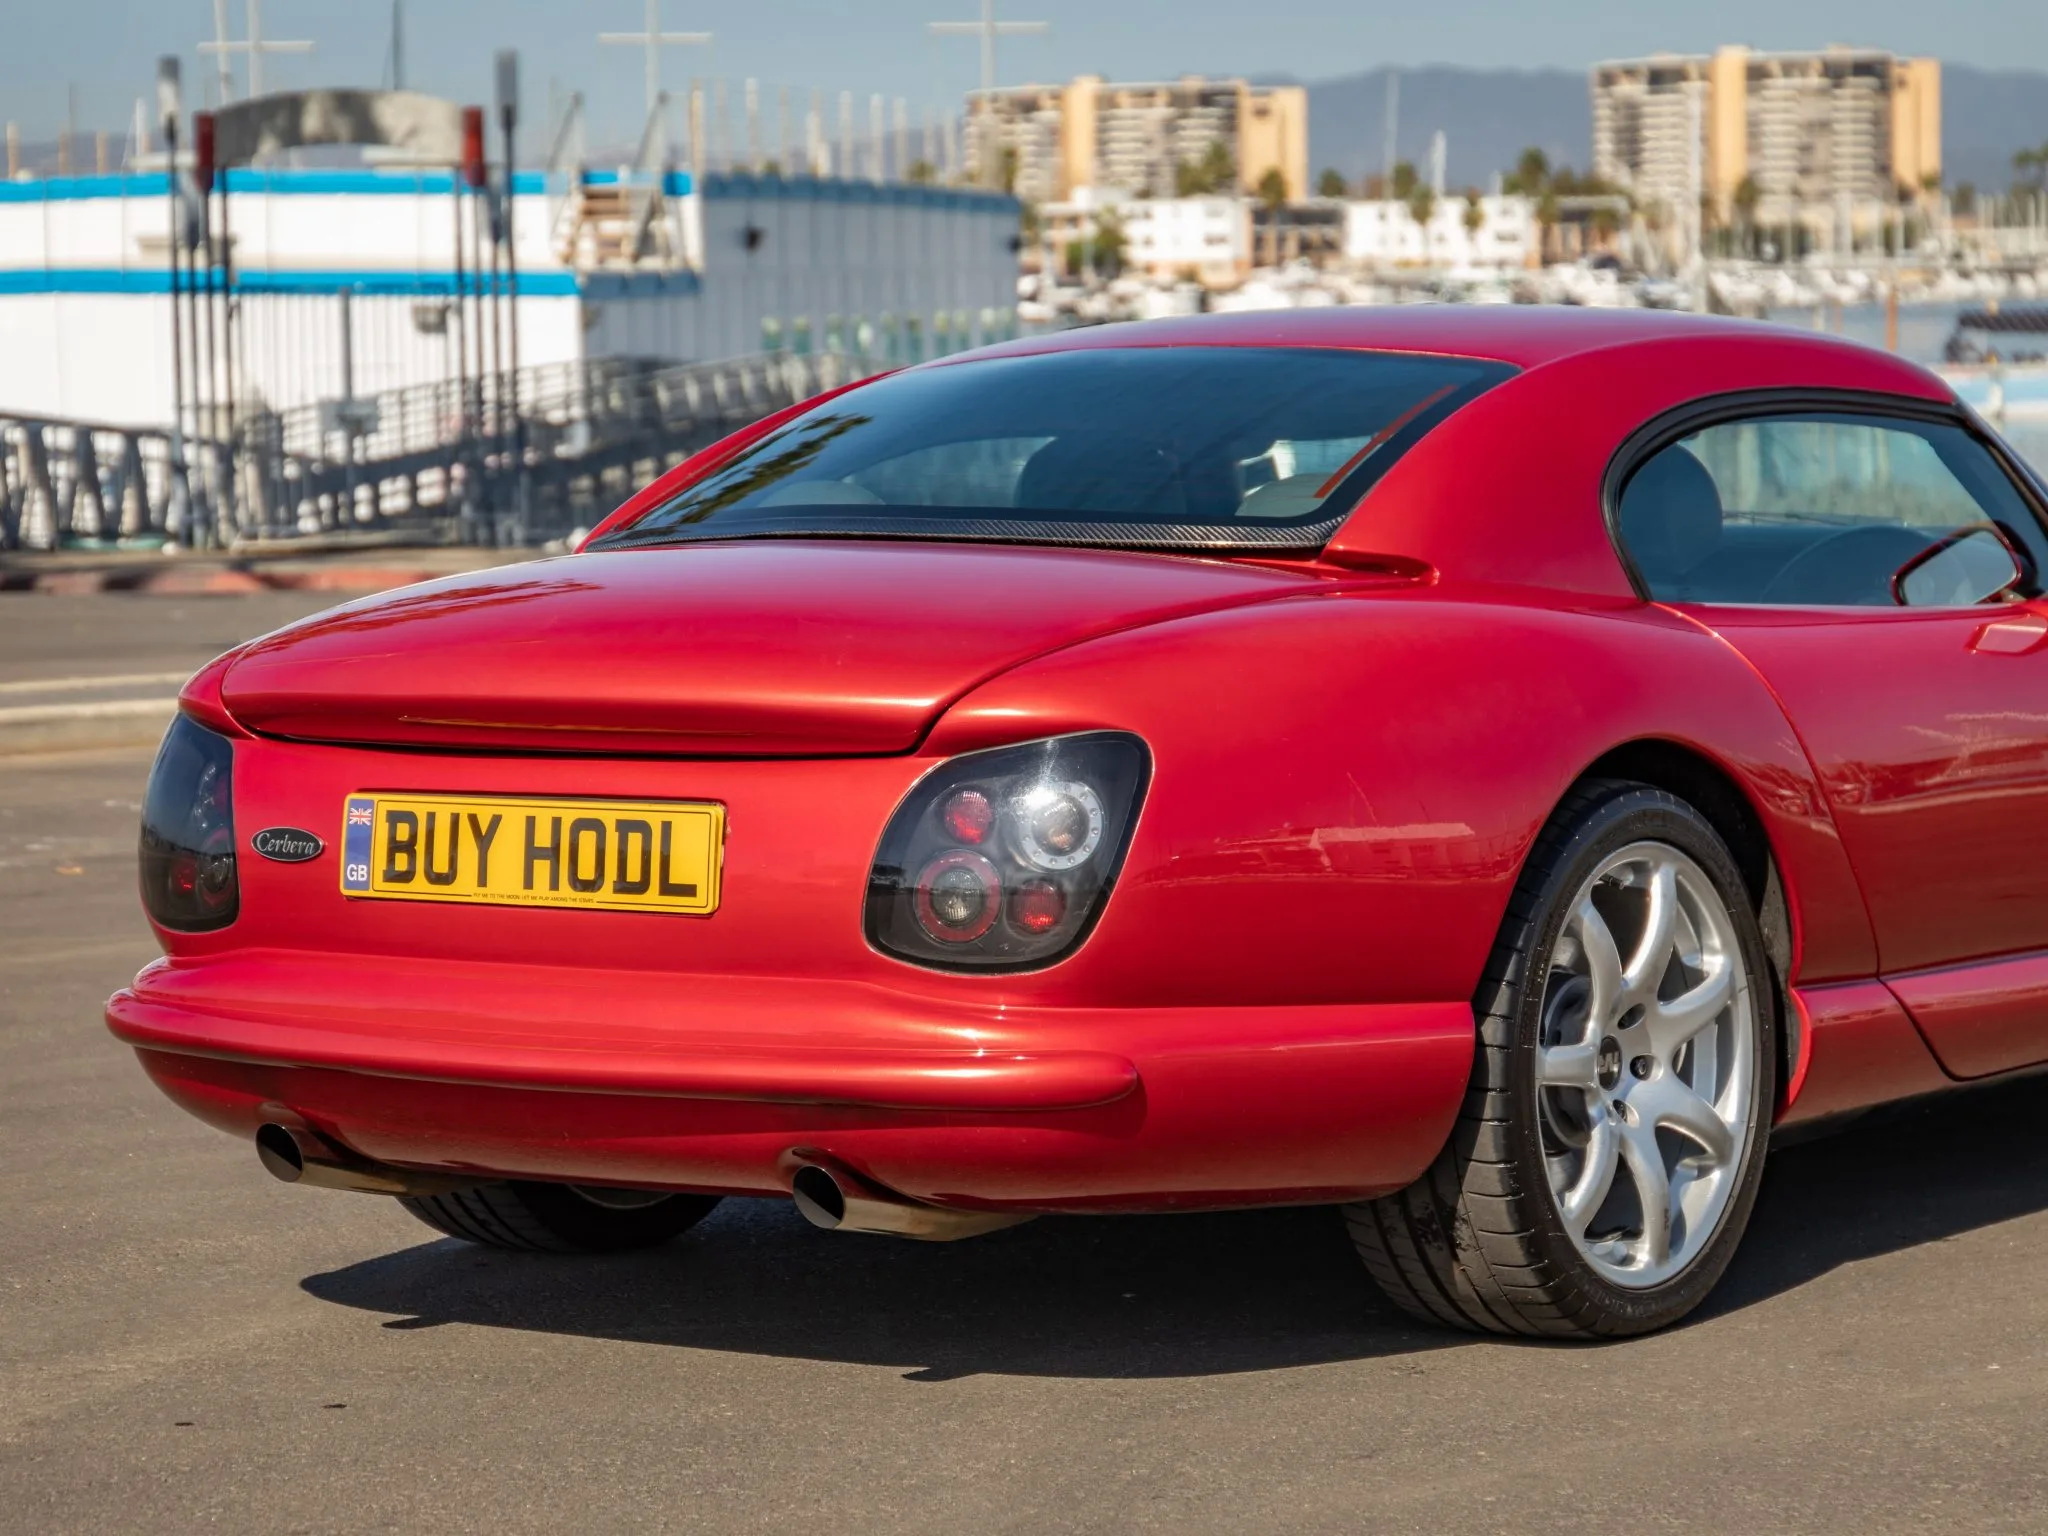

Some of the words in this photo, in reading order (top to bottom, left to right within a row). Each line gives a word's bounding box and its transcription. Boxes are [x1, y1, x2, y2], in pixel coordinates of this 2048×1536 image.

[256, 832, 315, 855] Cerbera
[382, 809, 502, 888] BUY
[522, 815, 698, 898] HODL
[346, 863, 369, 882] GB
